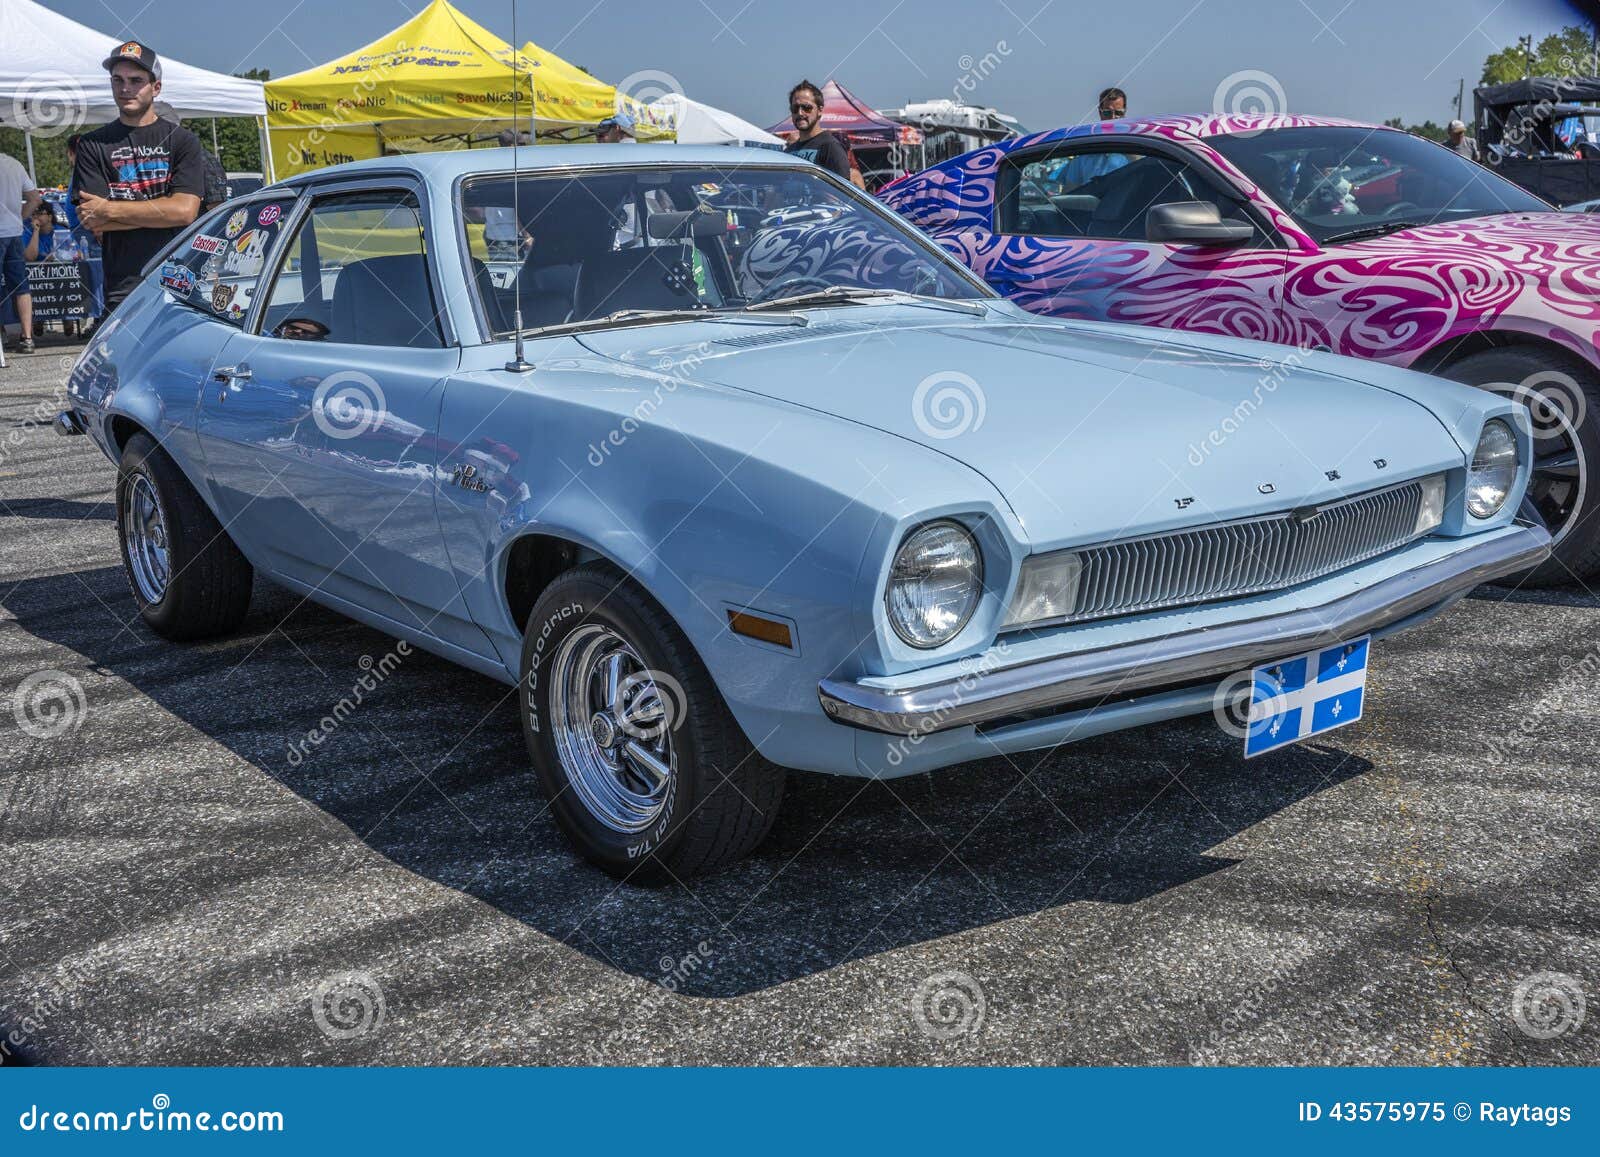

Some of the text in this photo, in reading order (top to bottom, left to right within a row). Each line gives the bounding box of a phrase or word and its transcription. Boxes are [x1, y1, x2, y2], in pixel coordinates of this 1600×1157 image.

[265, 99, 287, 112] Nic
[456, 91, 524, 105] SavoNic3D
[137, 145, 170, 157] Nova
[260, 206, 278, 222] STP
[192, 235, 220, 252] Castrol
[29, 282, 54, 290] ILLETS
[32, 295, 56, 303] ILLETS
[1175, 458, 1388, 510] FORD
[528, 602, 583, 733] BFGoodrich
